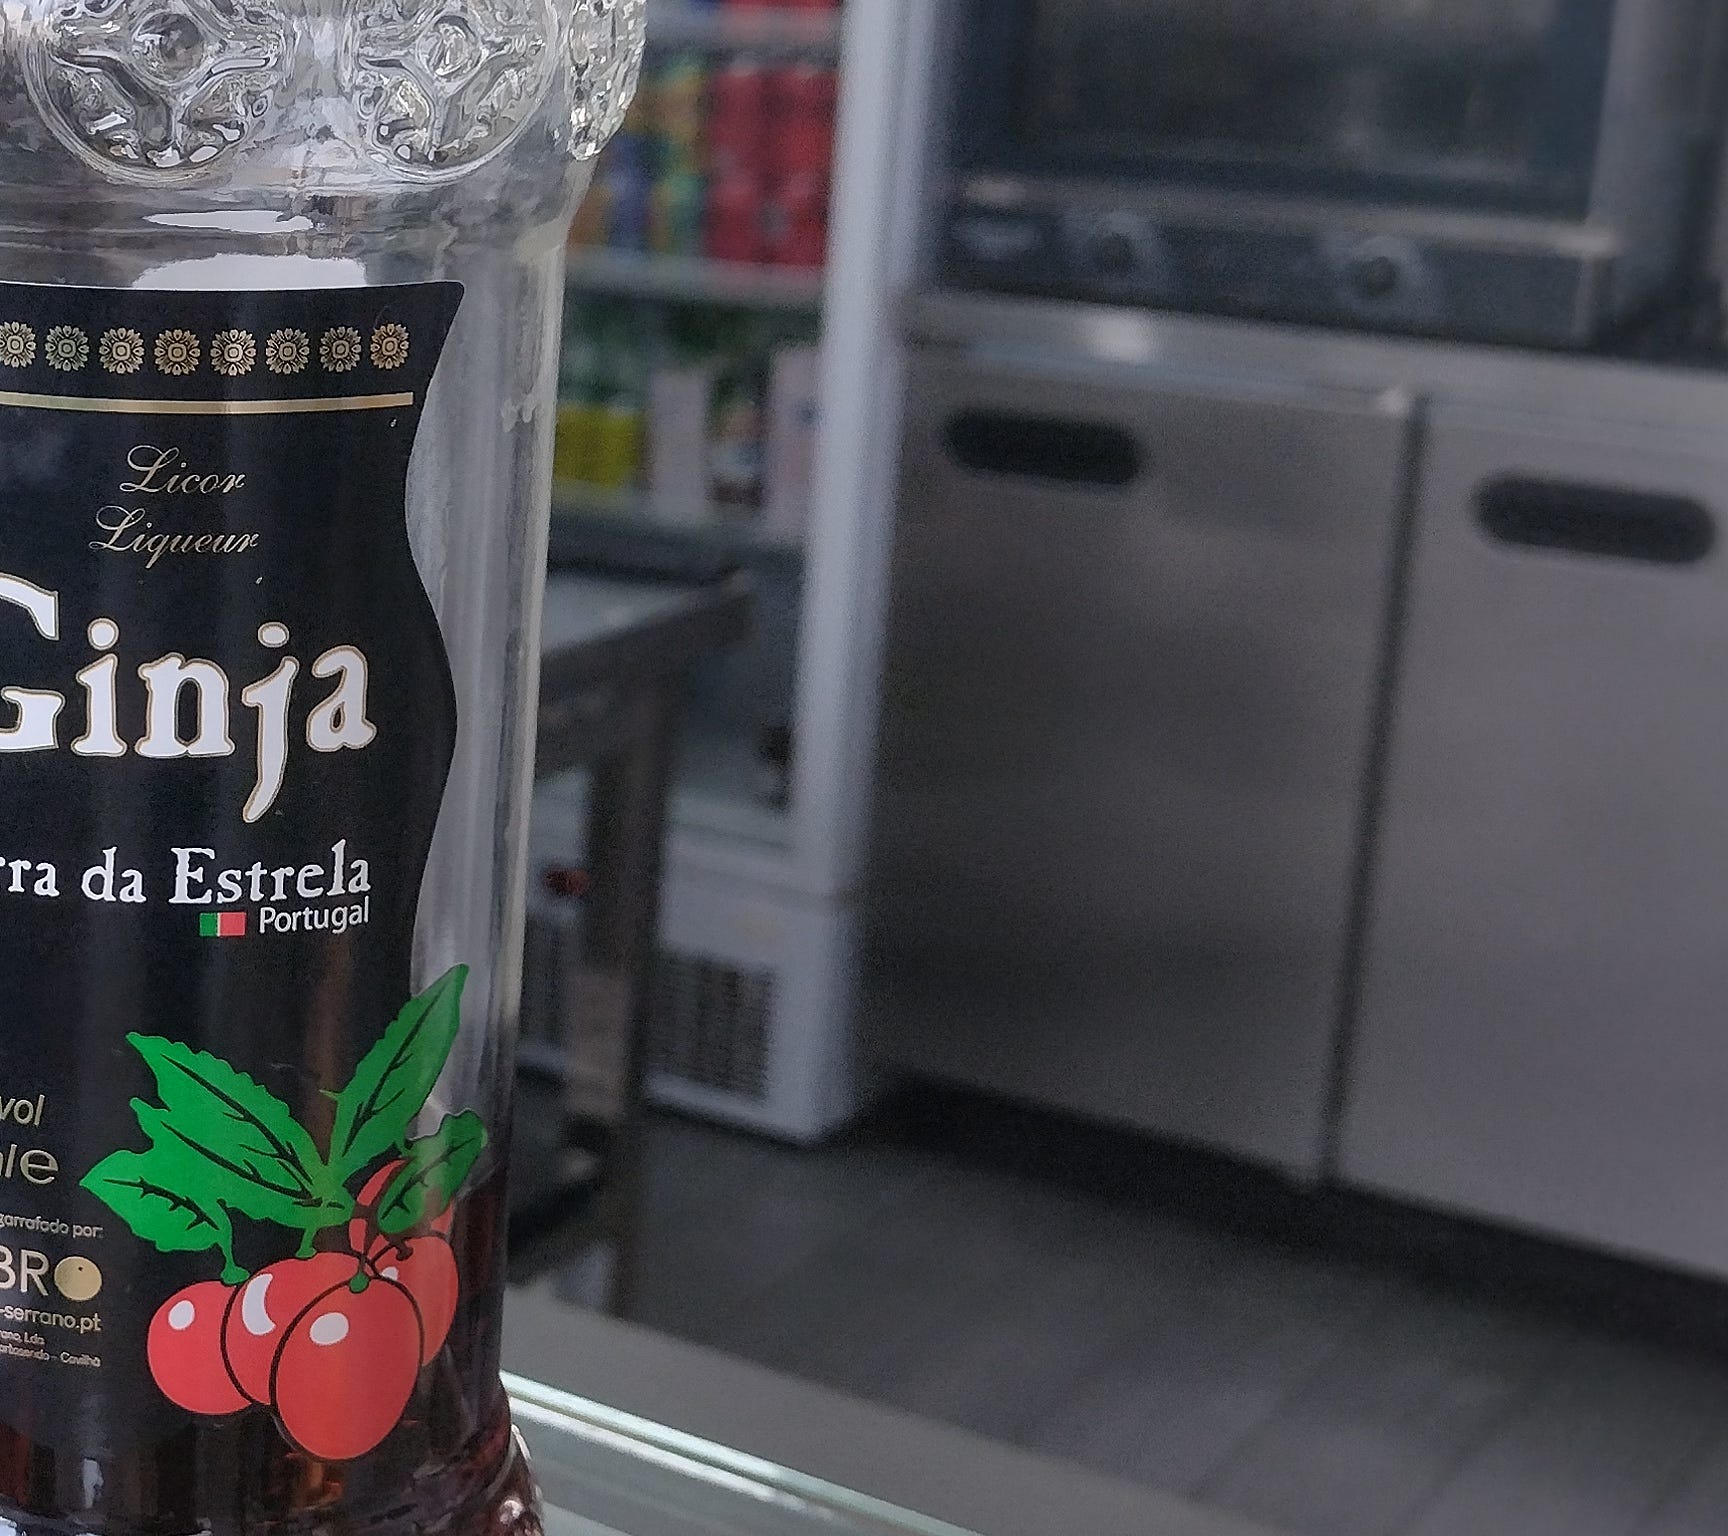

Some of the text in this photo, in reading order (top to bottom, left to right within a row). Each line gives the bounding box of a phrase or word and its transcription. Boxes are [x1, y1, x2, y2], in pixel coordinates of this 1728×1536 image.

[120, 445, 246, 494] Licor
[89, 505, 260, 569] Liqueur
[81, 848, 147, 904] da
[169, 839, 371, 905] Estrela
[258, 897, 370, 935] Portugal
